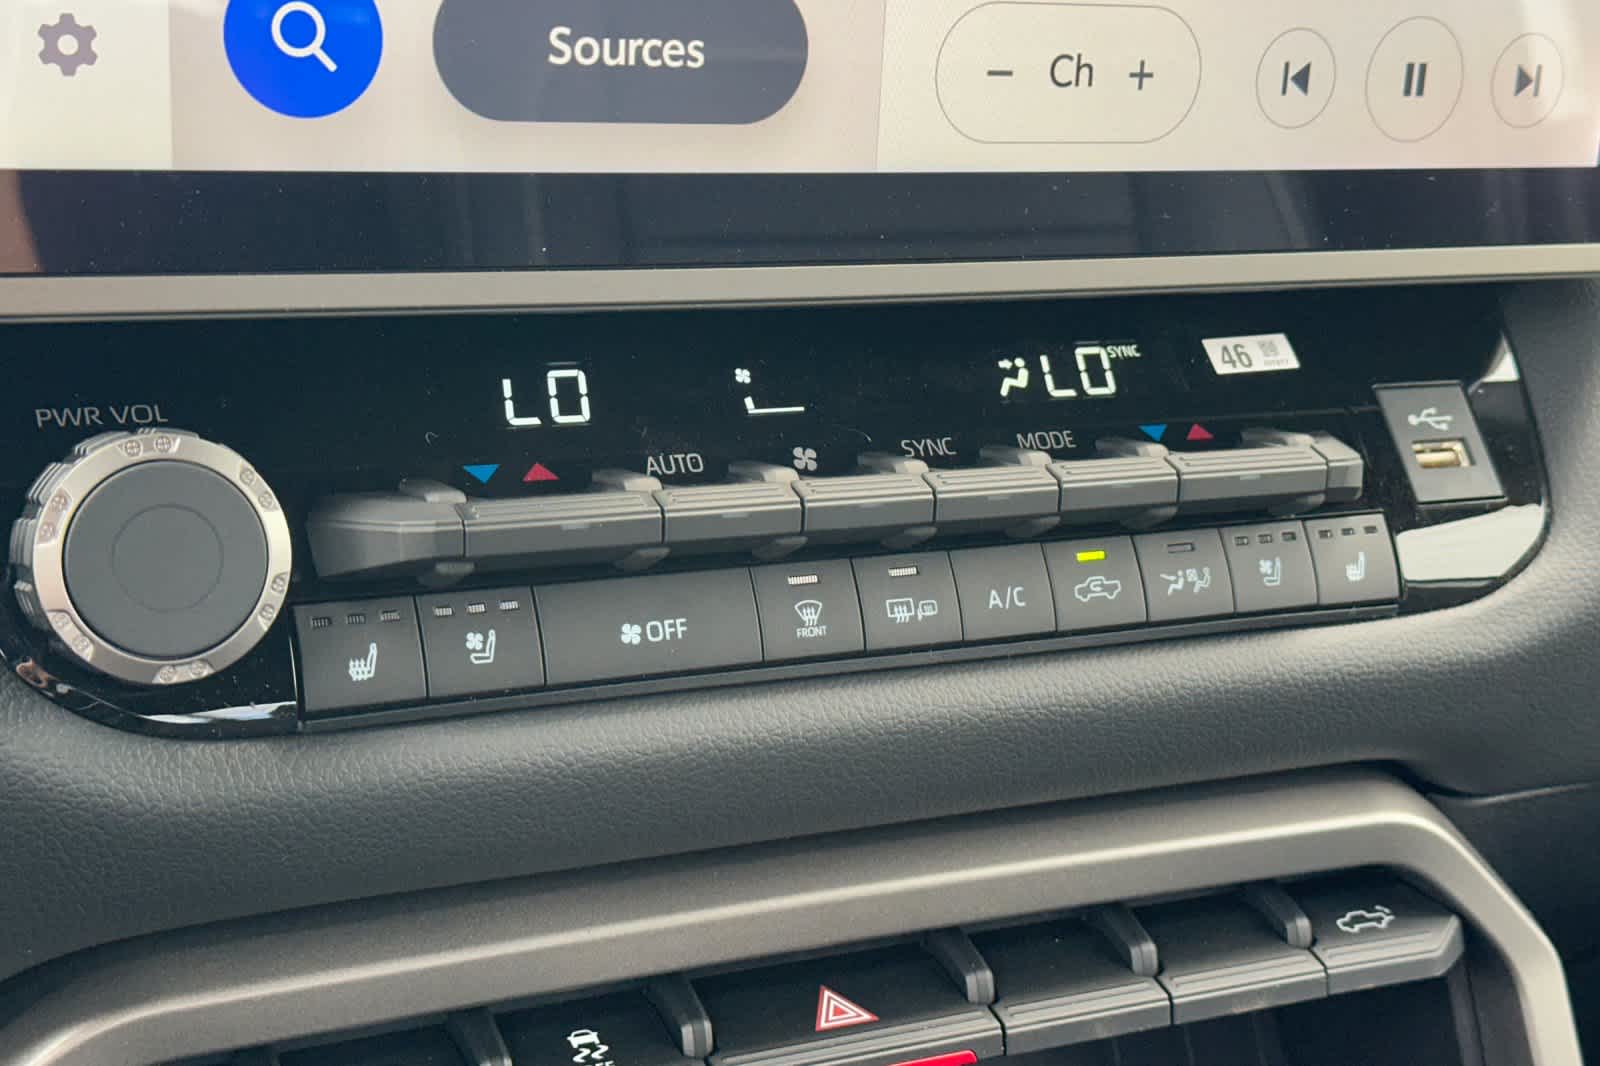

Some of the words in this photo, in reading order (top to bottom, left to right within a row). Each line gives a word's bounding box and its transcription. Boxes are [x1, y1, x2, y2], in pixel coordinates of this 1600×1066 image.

[547, 26, 706, 70] Sources
[1049, 54, 1094, 88] Ch
[1107, 344, 1141, 360] SYNC
[1220, 344, 1253, 369] 46
[35, 407, 103, 429] PWR
[110, 404, 169, 424] VOL
[900, 436, 957, 458] SYNC
[1016, 429, 1077, 451] MODE
[646, 453, 705, 477] AUTO
[987, 586, 1026, 609] A/C
[645, 617, 688, 643] OFF
[796, 625, 828, 640] FRONT
